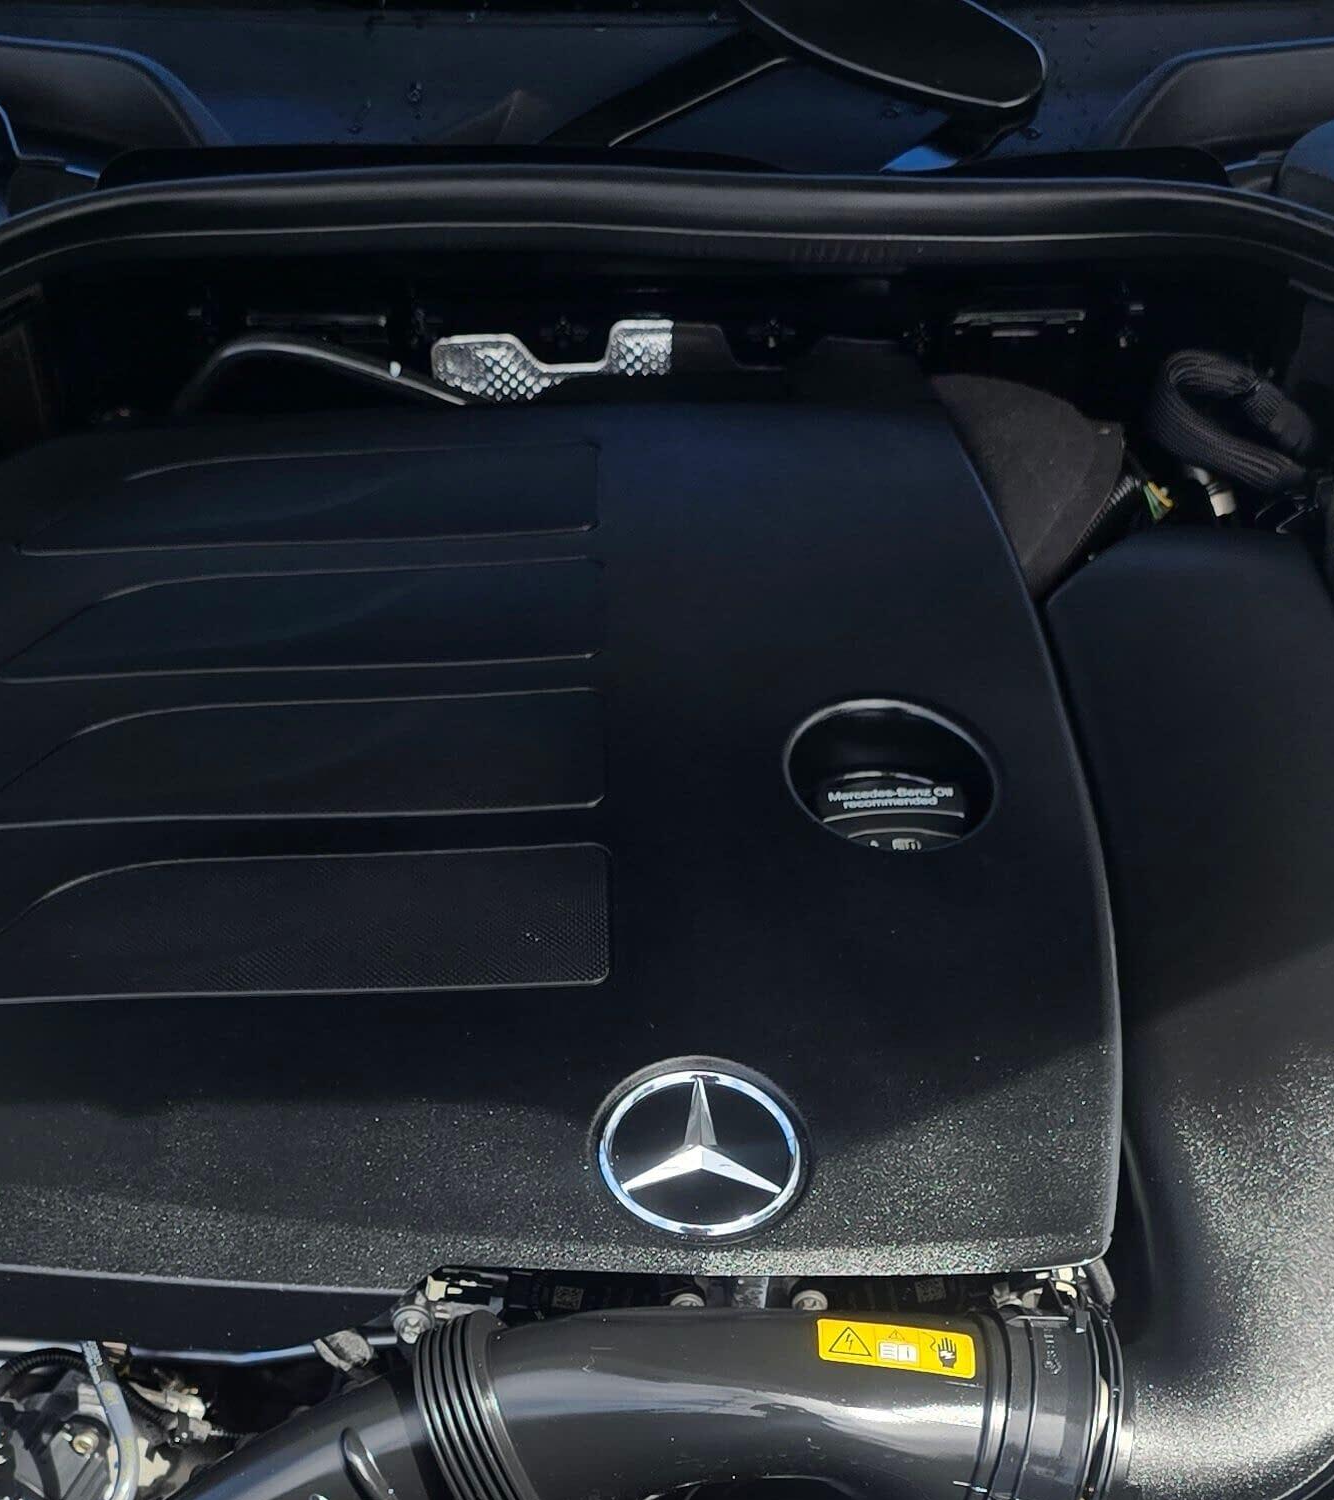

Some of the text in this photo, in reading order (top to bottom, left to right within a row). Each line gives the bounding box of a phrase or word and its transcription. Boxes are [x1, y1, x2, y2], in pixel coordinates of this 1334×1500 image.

[827, 786, 955, 802] Mercedes-Benz Oil
[842, 797, 939, 809] recommended
